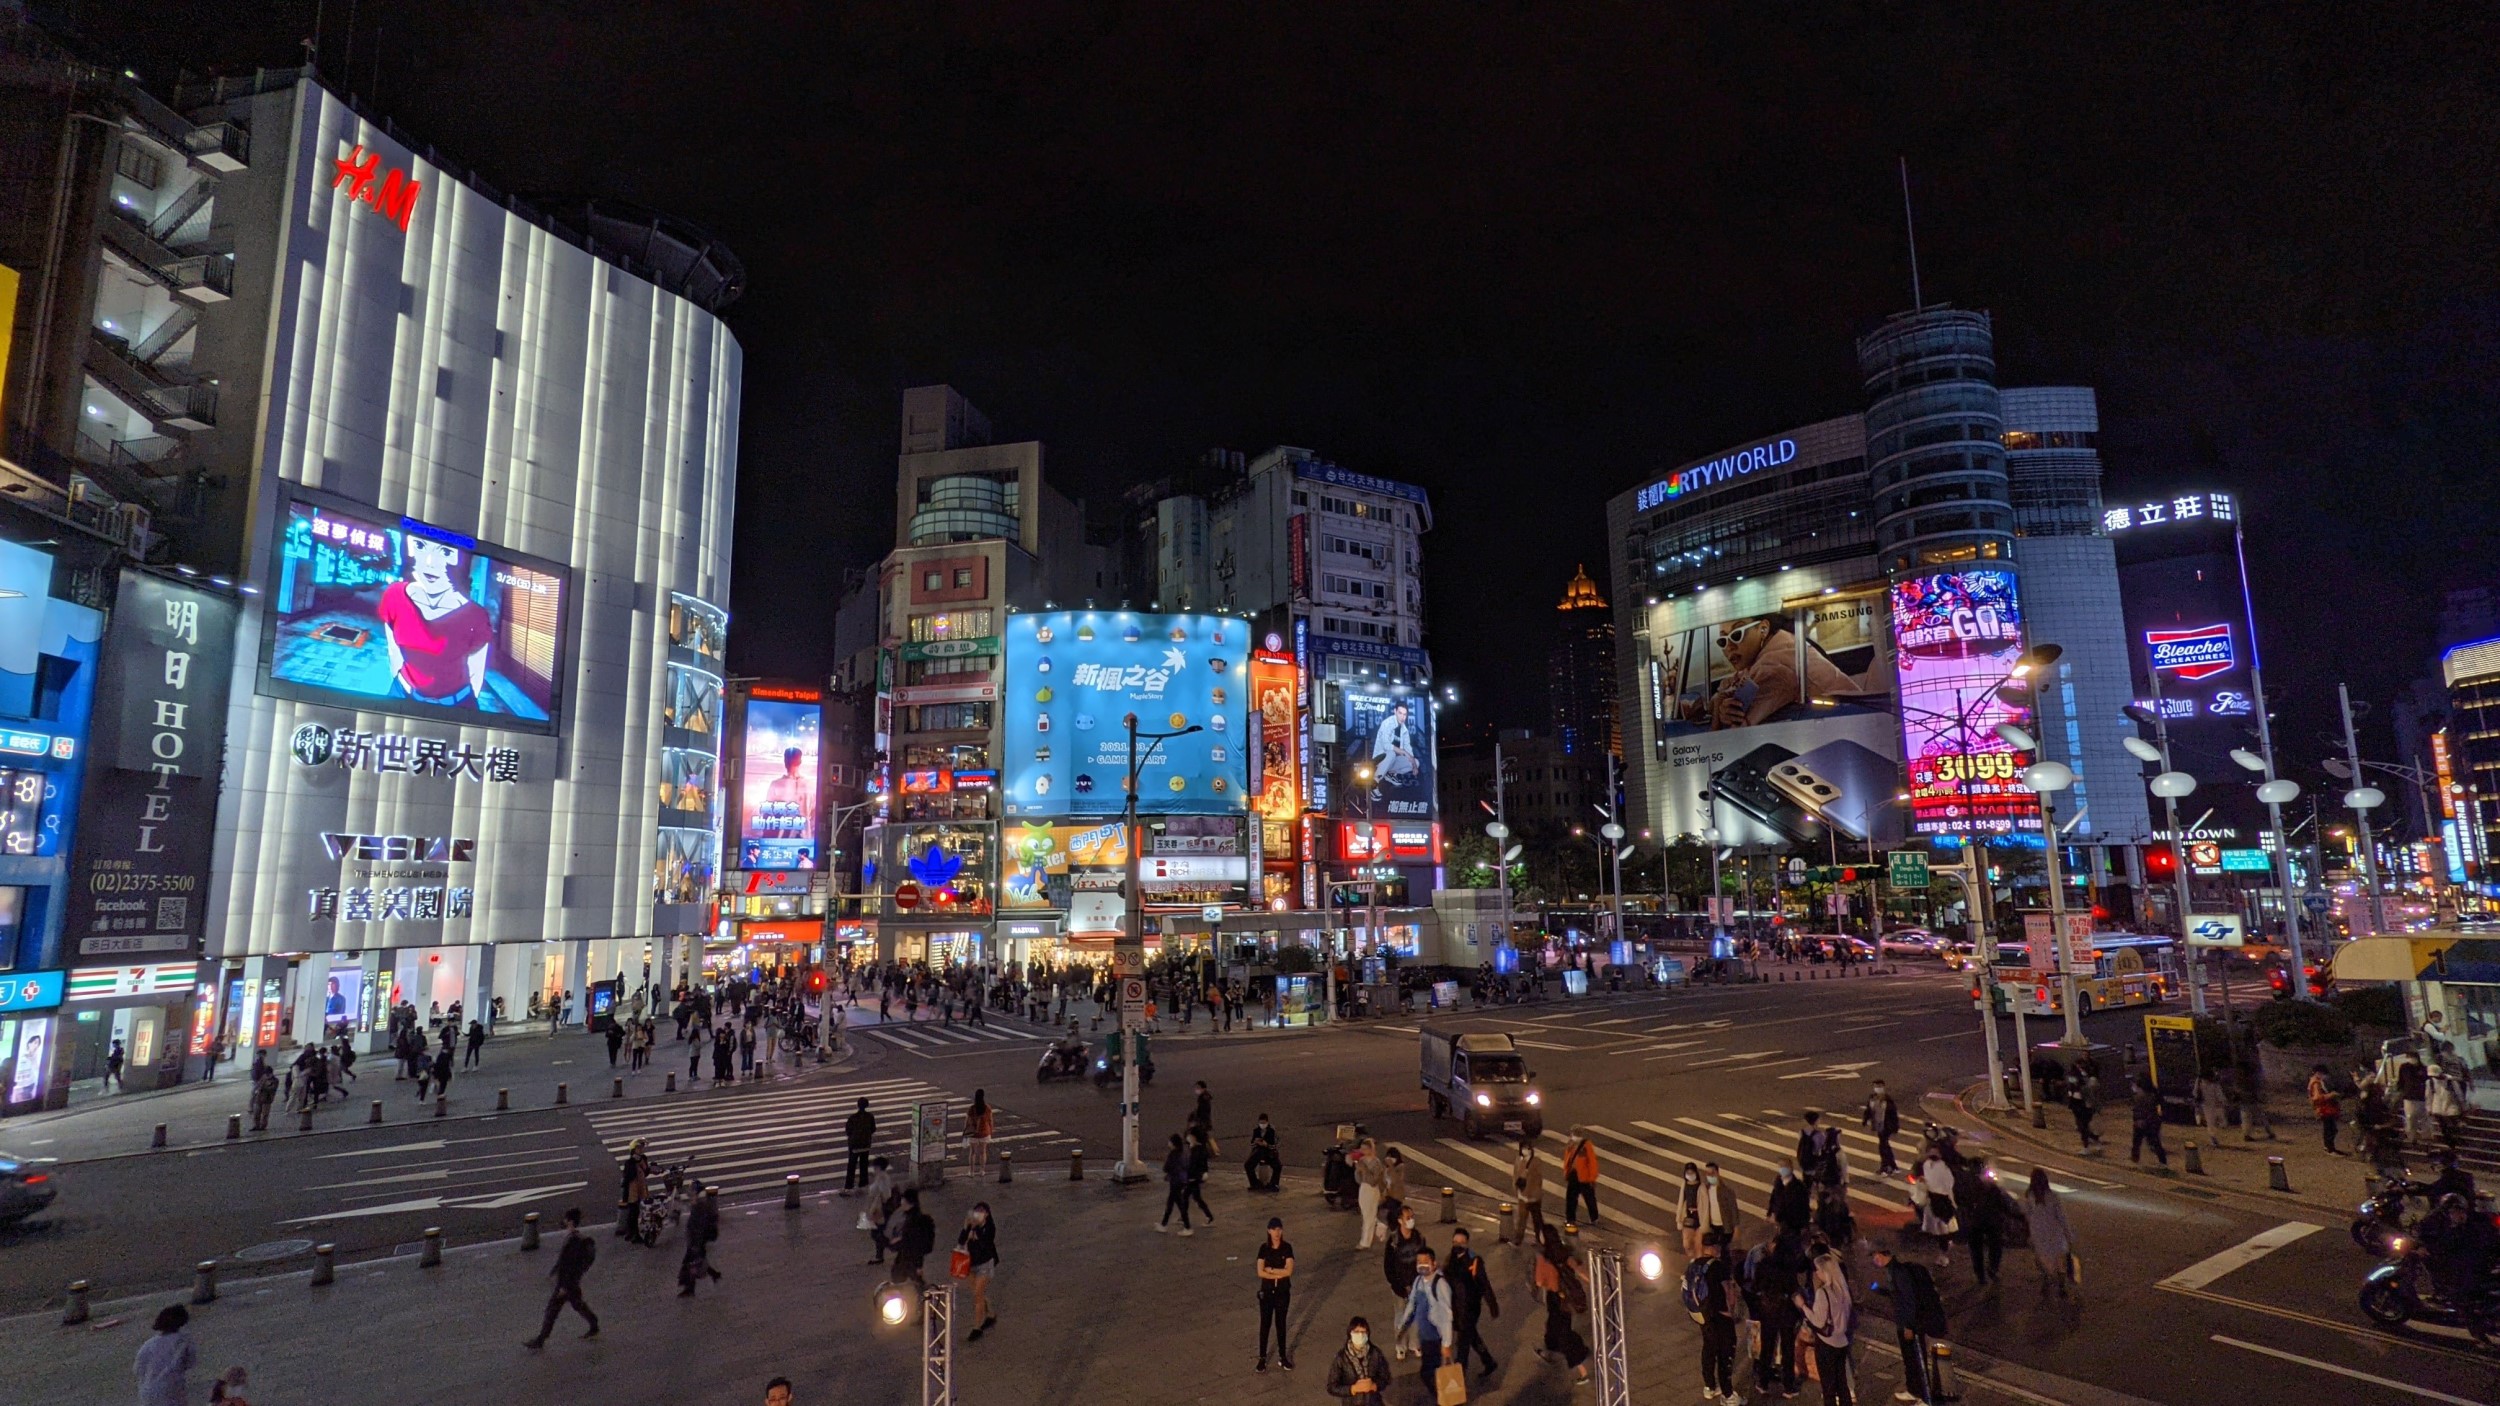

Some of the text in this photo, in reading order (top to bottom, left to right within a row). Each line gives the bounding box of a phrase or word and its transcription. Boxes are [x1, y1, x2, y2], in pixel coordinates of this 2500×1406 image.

[331, 144, 422, 233] H&M
[1658, 439, 1796, 503] PARTYWORLD
[2103, 495, 2203, 531] 德立莊
[312, 517, 386, 551] 盜夢偵探
[402, 515, 476, 550] Panasonic
[1814, 606, 1873, 624] SAMSUNG
[2154, 639, 2230, 660] Bleacher
[2164, 652, 2226, 664] CREATURES
[1072, 662, 1171, 692] 新楓之谷
[751, 687, 819, 701] Ximending Taipei
[1348, 694, 1391, 704] SKECHERS
[2167, 698, 2193, 714] Store
[135, 599, 199, 853] 明日 HOTEL
[333, 726, 521, 784] 新世界大樓
[1096, 755, 1167, 765] GAME TART
[1672, 745, 1702, 756] Galaxy
[1711, 752, 1724, 763] 5G
[1936, 753, 2014, 781] 3099
[1070, 822, 1126, 851] 西門町
[90, 873, 195, 894] (02)2375-5500
[1170, 868, 1190, 876] RICH
[308, 886, 476, 922] 真善美劇院
